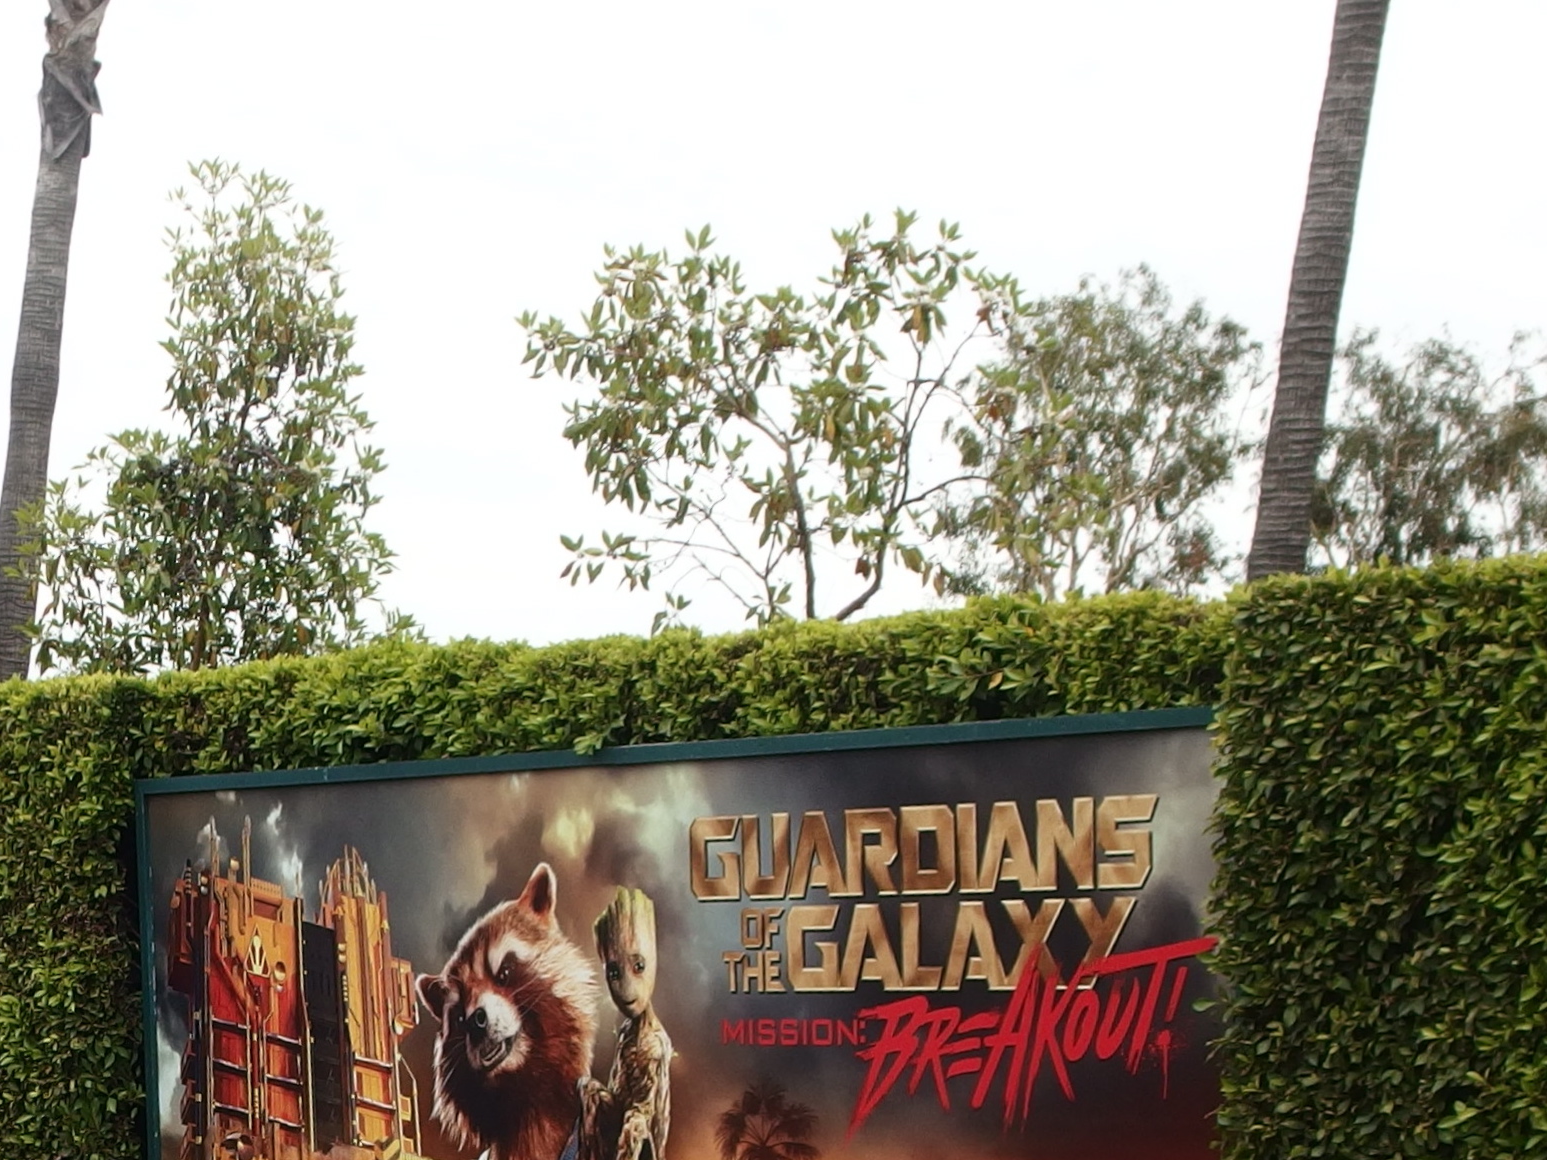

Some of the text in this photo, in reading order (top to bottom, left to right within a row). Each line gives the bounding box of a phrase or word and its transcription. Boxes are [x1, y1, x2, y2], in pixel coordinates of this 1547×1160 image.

[688, 794, 1159, 901] GUARDIANS
[723, 950, 787, 993] THE
[740, 907, 783, 949] OF
[787, 896, 1137, 992] GALAXY
[720, 936, 1219, 1147] MISSION: BREAKOUT!
